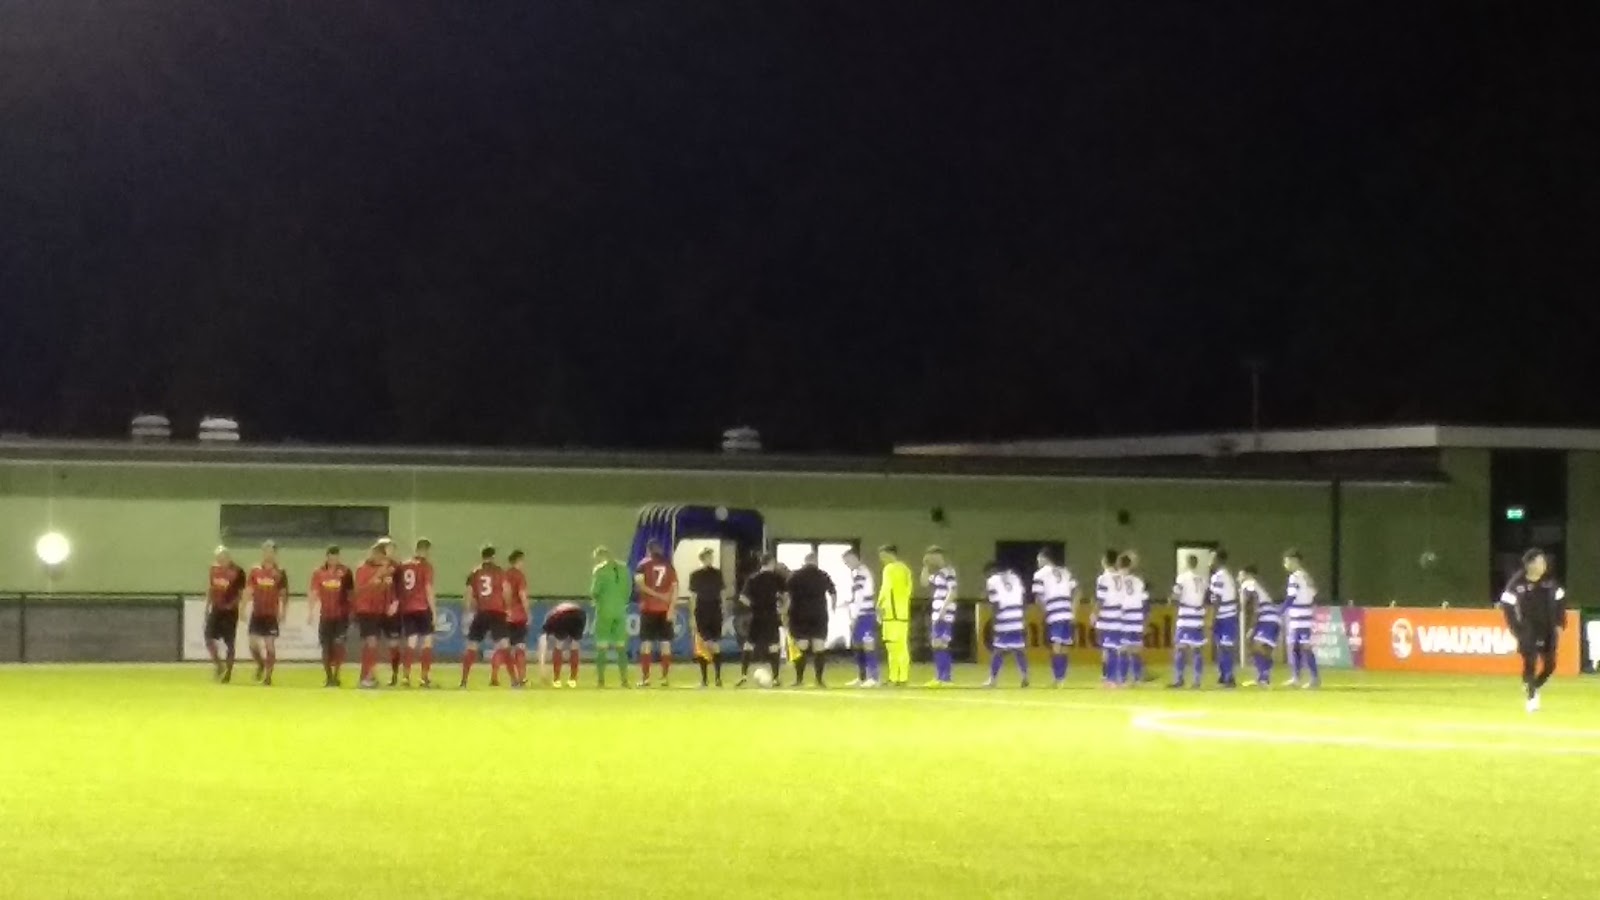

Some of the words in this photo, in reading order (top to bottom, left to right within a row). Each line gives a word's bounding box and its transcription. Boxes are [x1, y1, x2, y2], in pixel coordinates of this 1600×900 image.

[404, 569, 416, 590] 9
[480, 575, 493, 597] 3
[652, 566, 666, 587] 7
[1417, 625, 1518, 655] VAUXHA
